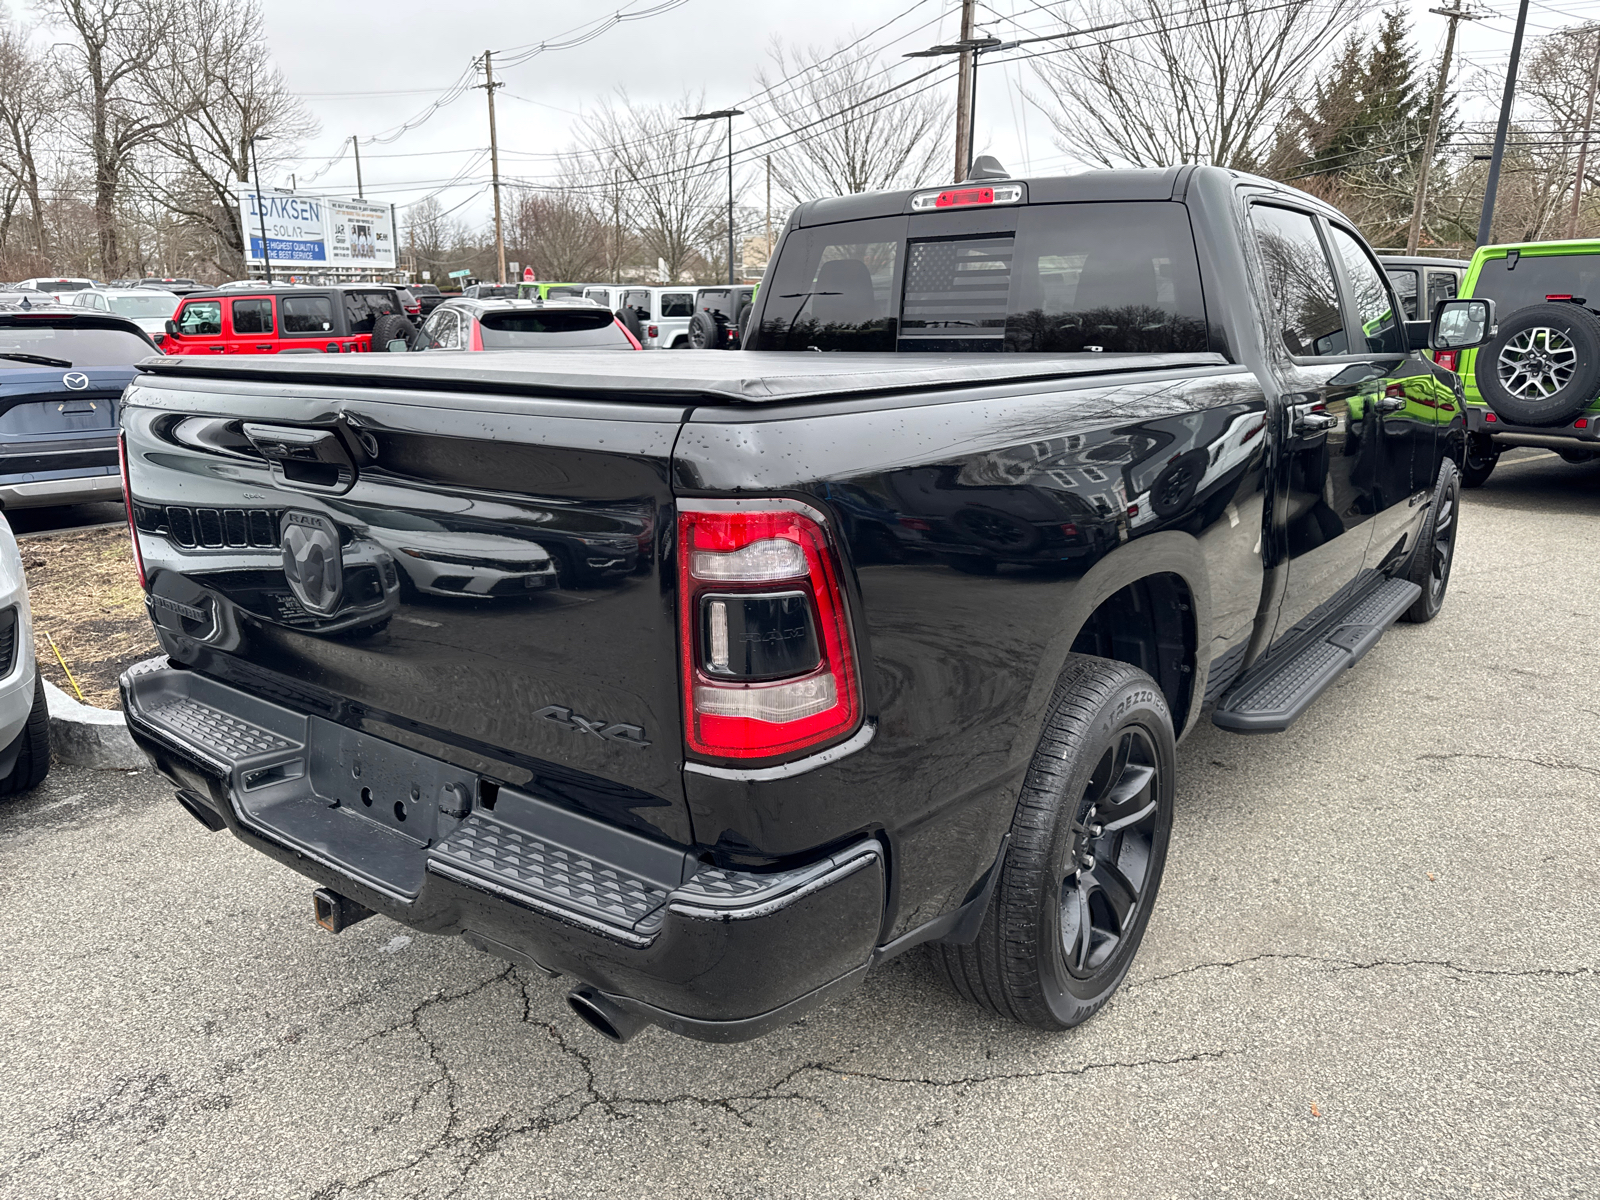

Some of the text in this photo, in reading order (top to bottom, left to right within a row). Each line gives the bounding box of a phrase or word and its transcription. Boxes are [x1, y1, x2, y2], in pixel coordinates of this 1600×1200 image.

[248, 194, 320, 222] ISAKSEN
[273, 224, 303, 238] SOLAR
[271, 242, 293, 251] HIGHEST
[293, 243, 313, 252] QUALITY
[267, 250, 313, 260] THE BEST SERVICE
[288, 513, 323, 527] RAM
[739, 626, 805, 642] RAM
